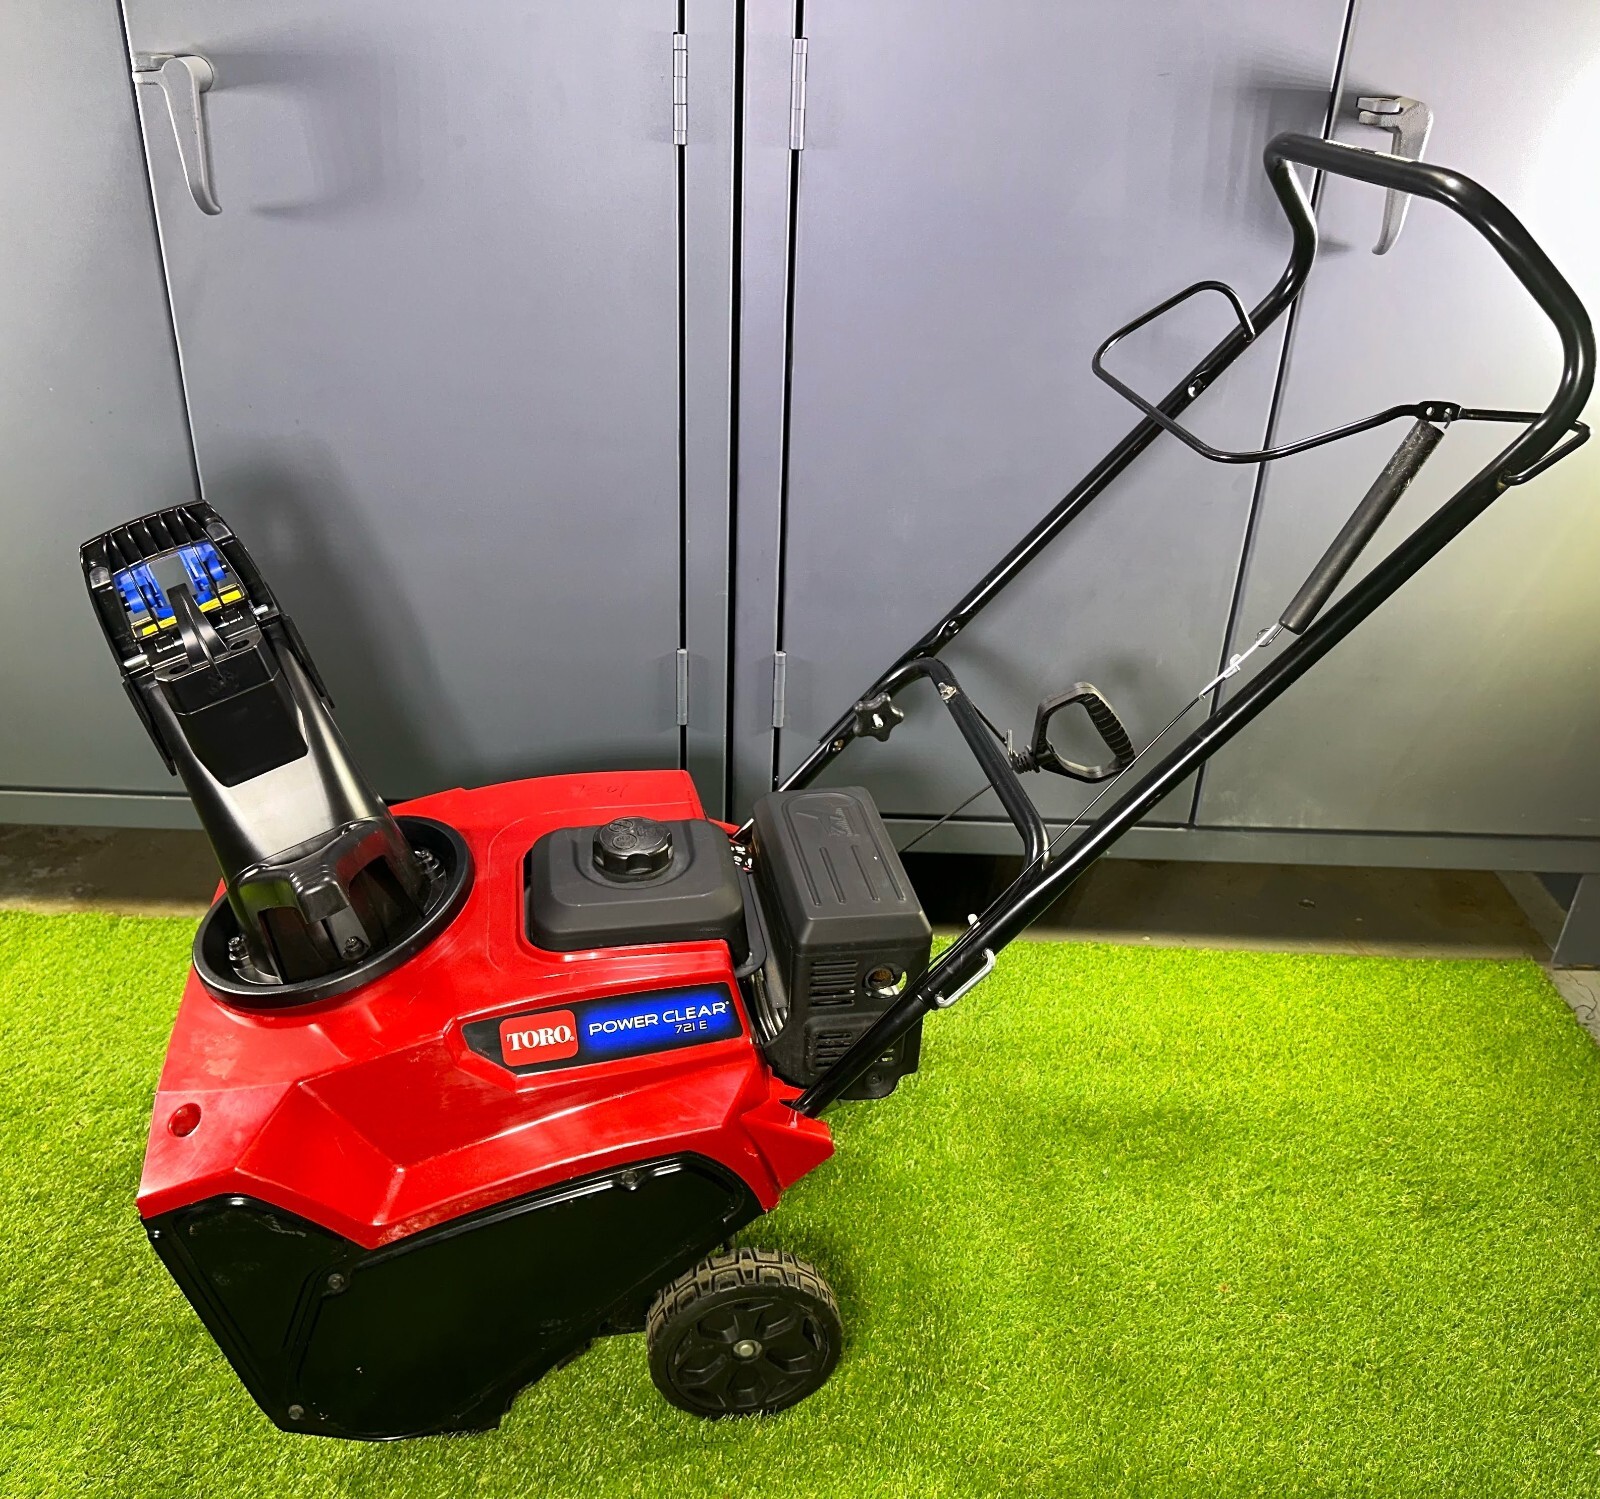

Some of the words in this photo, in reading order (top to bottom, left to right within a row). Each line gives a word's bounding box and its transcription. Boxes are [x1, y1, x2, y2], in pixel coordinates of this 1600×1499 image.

[588, 1013, 659, 1036] POWER
[662, 1001, 727, 1023] CLEAR
[674, 1022, 696, 1034] 721
[699, 1020, 708, 1030] E
[506, 1025, 572, 1051] TORO
